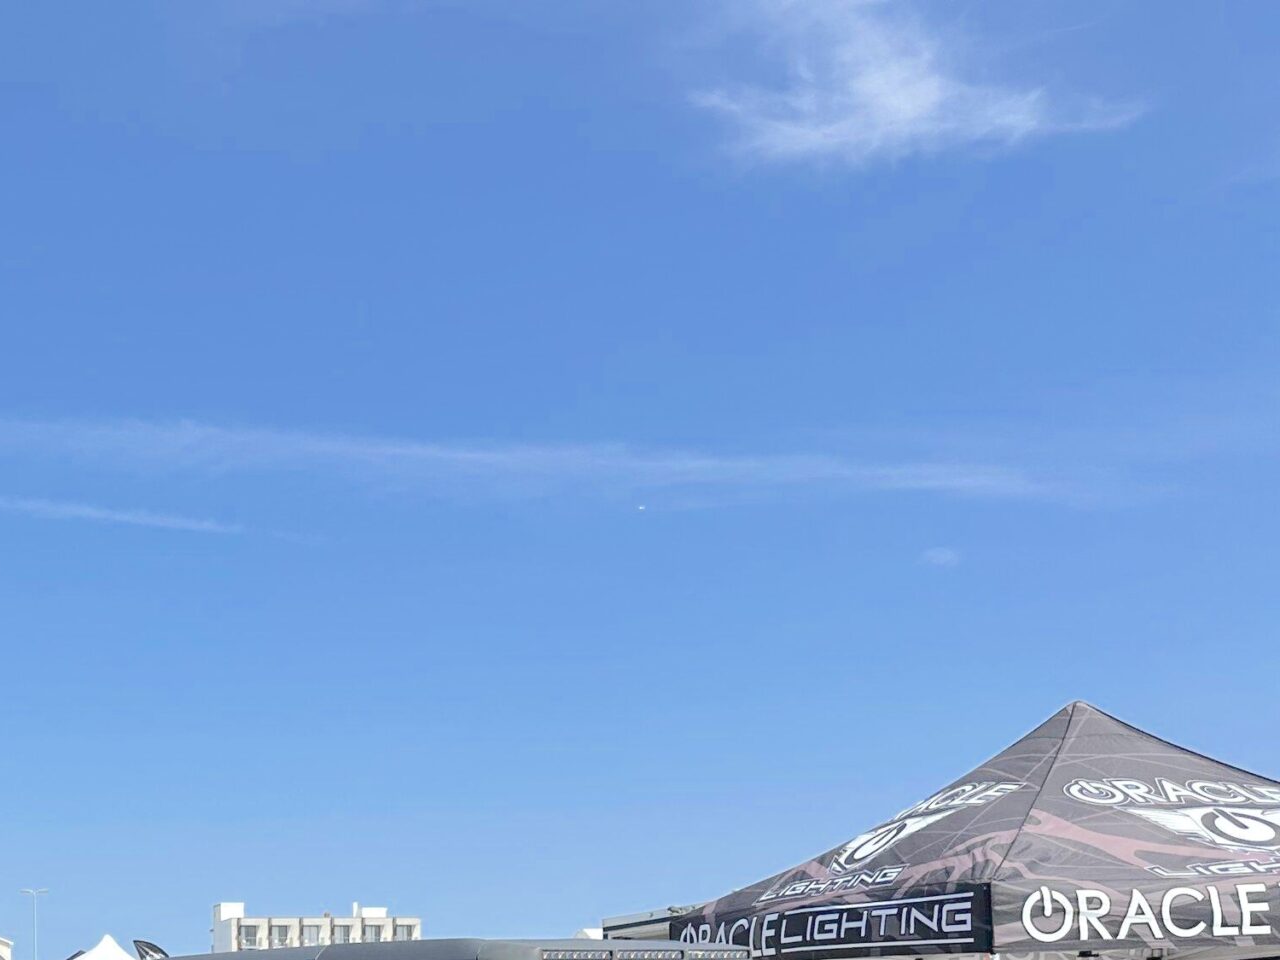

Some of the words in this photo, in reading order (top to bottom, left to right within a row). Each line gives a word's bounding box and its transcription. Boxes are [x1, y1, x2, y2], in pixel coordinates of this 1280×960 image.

[756, 864, 908, 905] LIGHTING
[780, 902, 971, 943] LIGHTING
[1022, 883, 1272, 943] ORACLE
